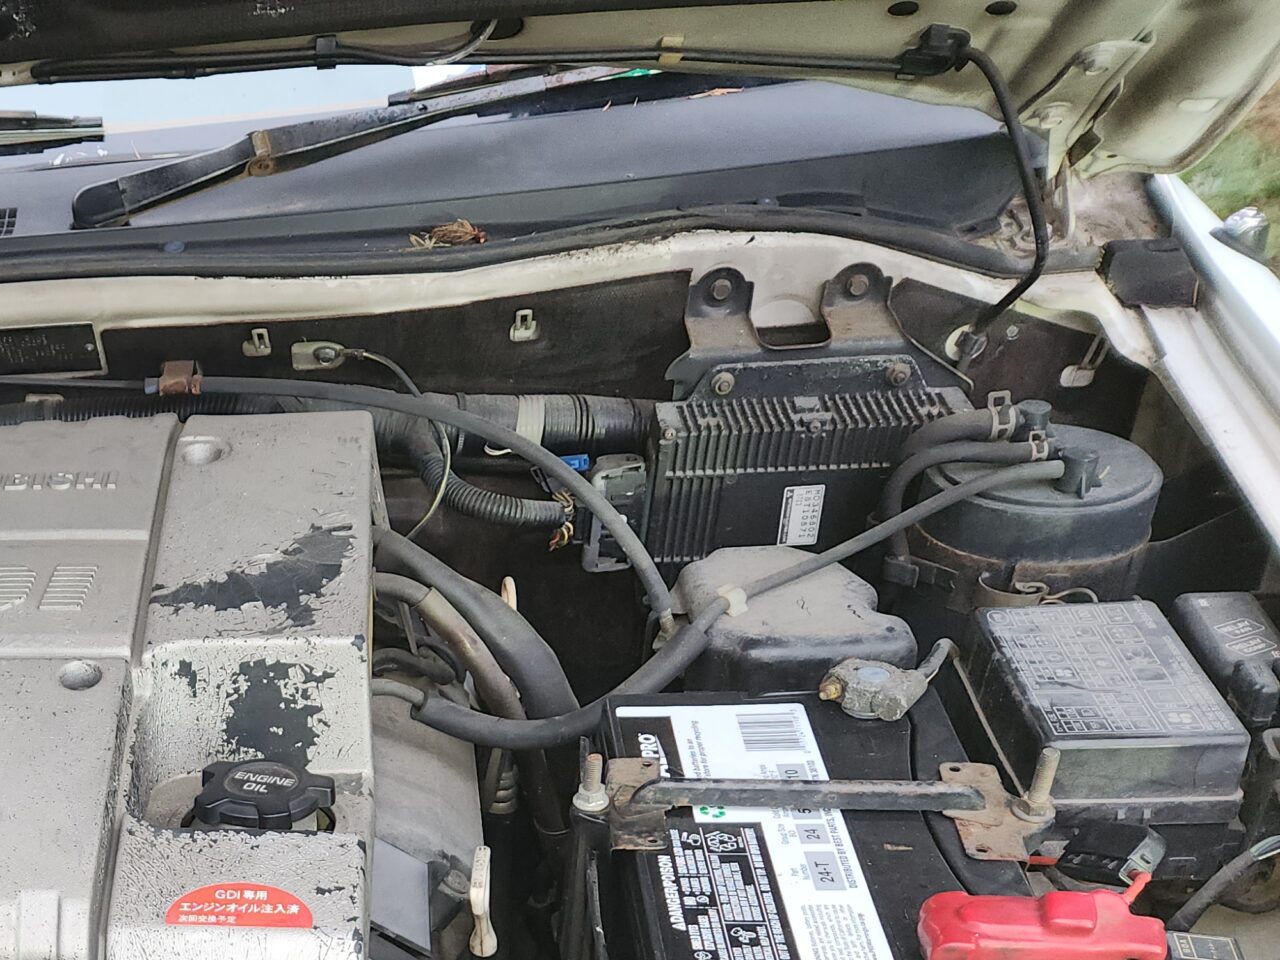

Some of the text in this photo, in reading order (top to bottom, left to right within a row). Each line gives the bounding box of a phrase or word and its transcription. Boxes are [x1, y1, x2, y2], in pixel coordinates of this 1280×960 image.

[637, 733, 659, 757] PRO
[234, 771, 296, 787] ENGINE
[242, 782, 269, 793] OIL
[803, 828, 820, 839] 24
[831, 834, 843, 846] BEST
[813, 861, 835, 882] 24-T
[838, 855, 858, 888] DISTRIBUTED
[215, 889, 241, 899] GDI
[178, 902, 300, 915] エンジンオイル注入済
